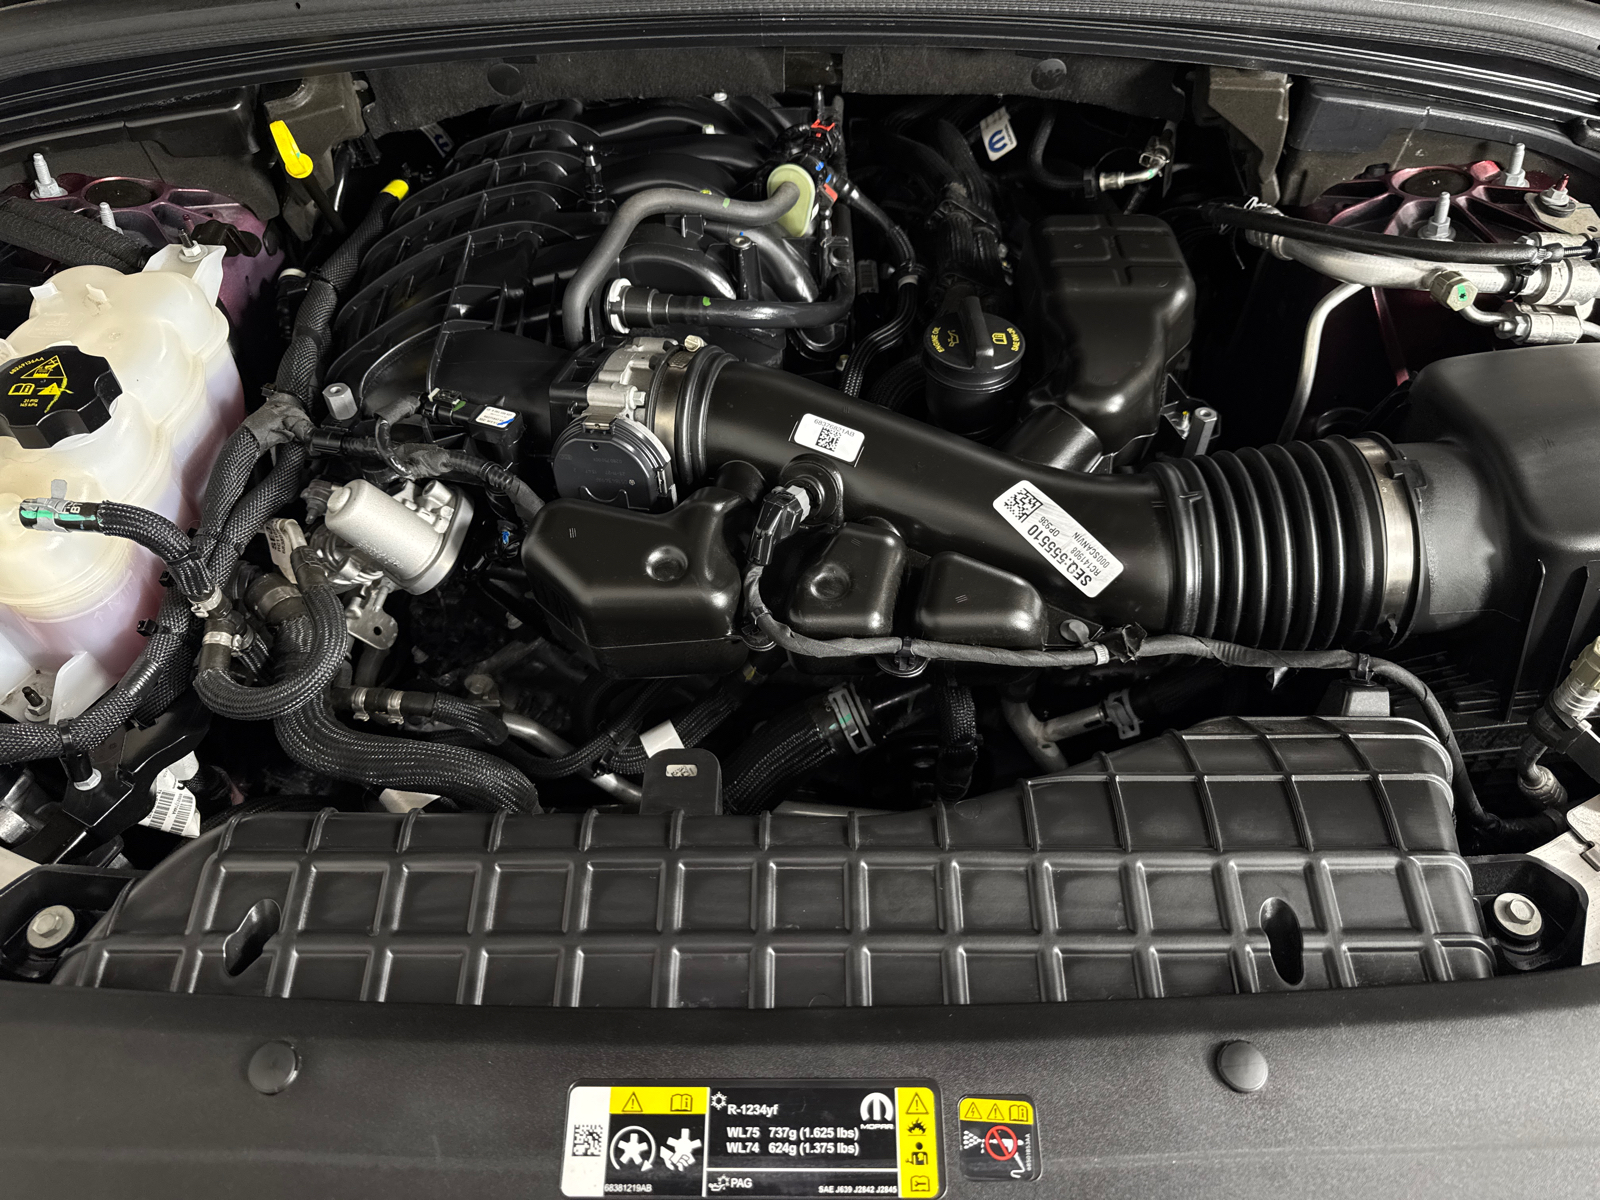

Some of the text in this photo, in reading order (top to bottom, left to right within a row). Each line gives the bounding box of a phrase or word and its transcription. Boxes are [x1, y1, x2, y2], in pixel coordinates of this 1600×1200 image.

[1027, 524, 1092, 587] SEQ:555510
[727, 1103, 779, 1116] R-1234yf
[726, 1126, 860, 1141] WL75 737g (1.625 lbs)
[726, 1142, 860, 1156] WL74 624g (1.375 lbs)
[730, 1178, 753, 1188] PAG
[817, 1185, 898, 1194] SAE J639 J2842 J2845
